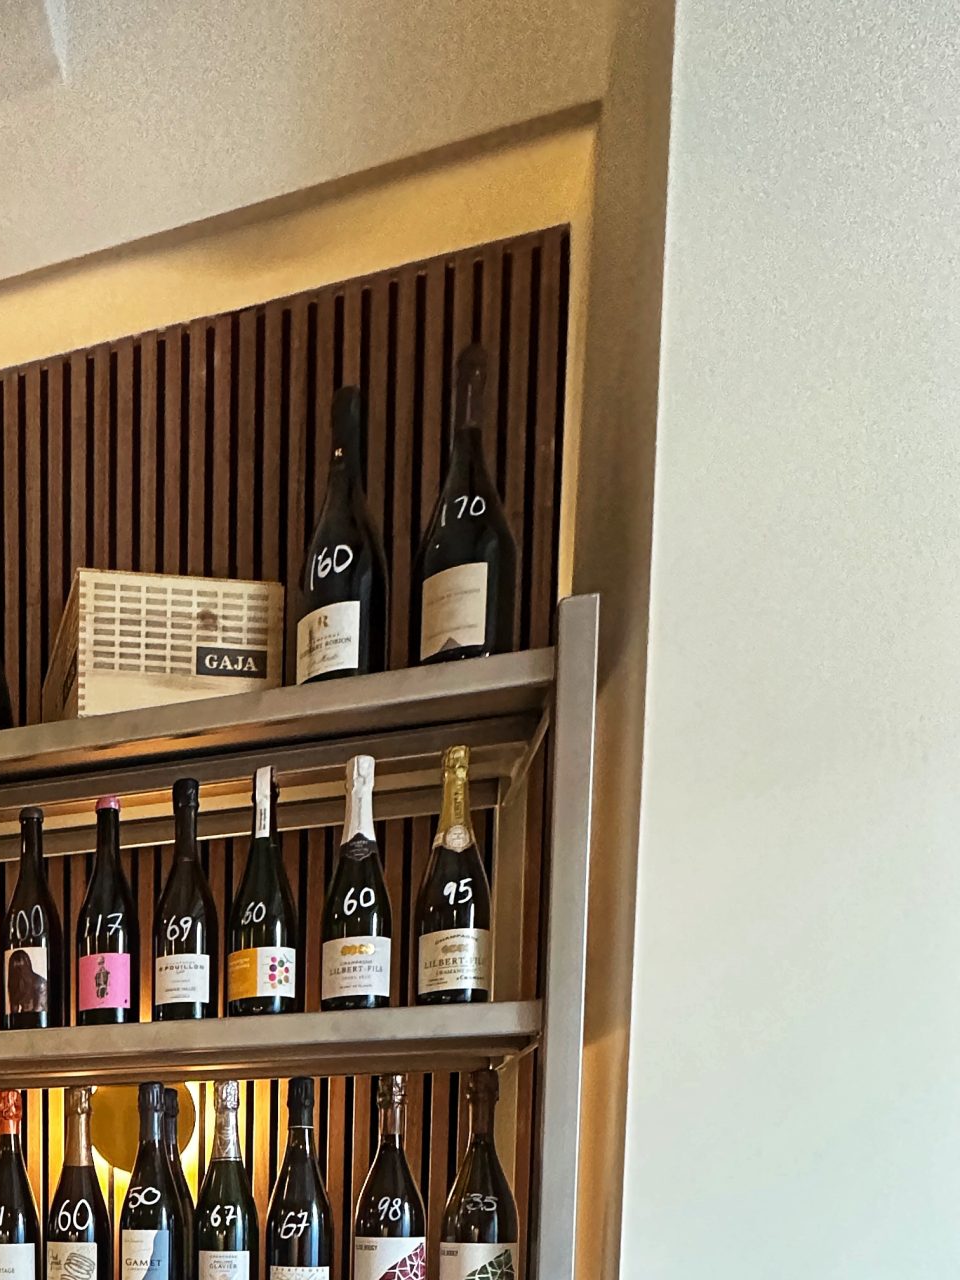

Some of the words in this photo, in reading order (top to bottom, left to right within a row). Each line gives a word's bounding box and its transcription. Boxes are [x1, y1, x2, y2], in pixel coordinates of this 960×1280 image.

[441, 495, 486, 527] 170
[310, 545, 353, 591] 160
[205, 654, 259, 672] GAJA
[343, 887, 376, 916] 60
[443, 878, 474, 906] 95
[166, 916, 193, 942] 69
[128, 1186, 162, 1209] 50
[378, 1196, 402, 1221] 98
[57, 1198, 90, 1232] 60
[280, 1211, 311, 1240] 67
[125, 1258, 162, 1267] GAMET
